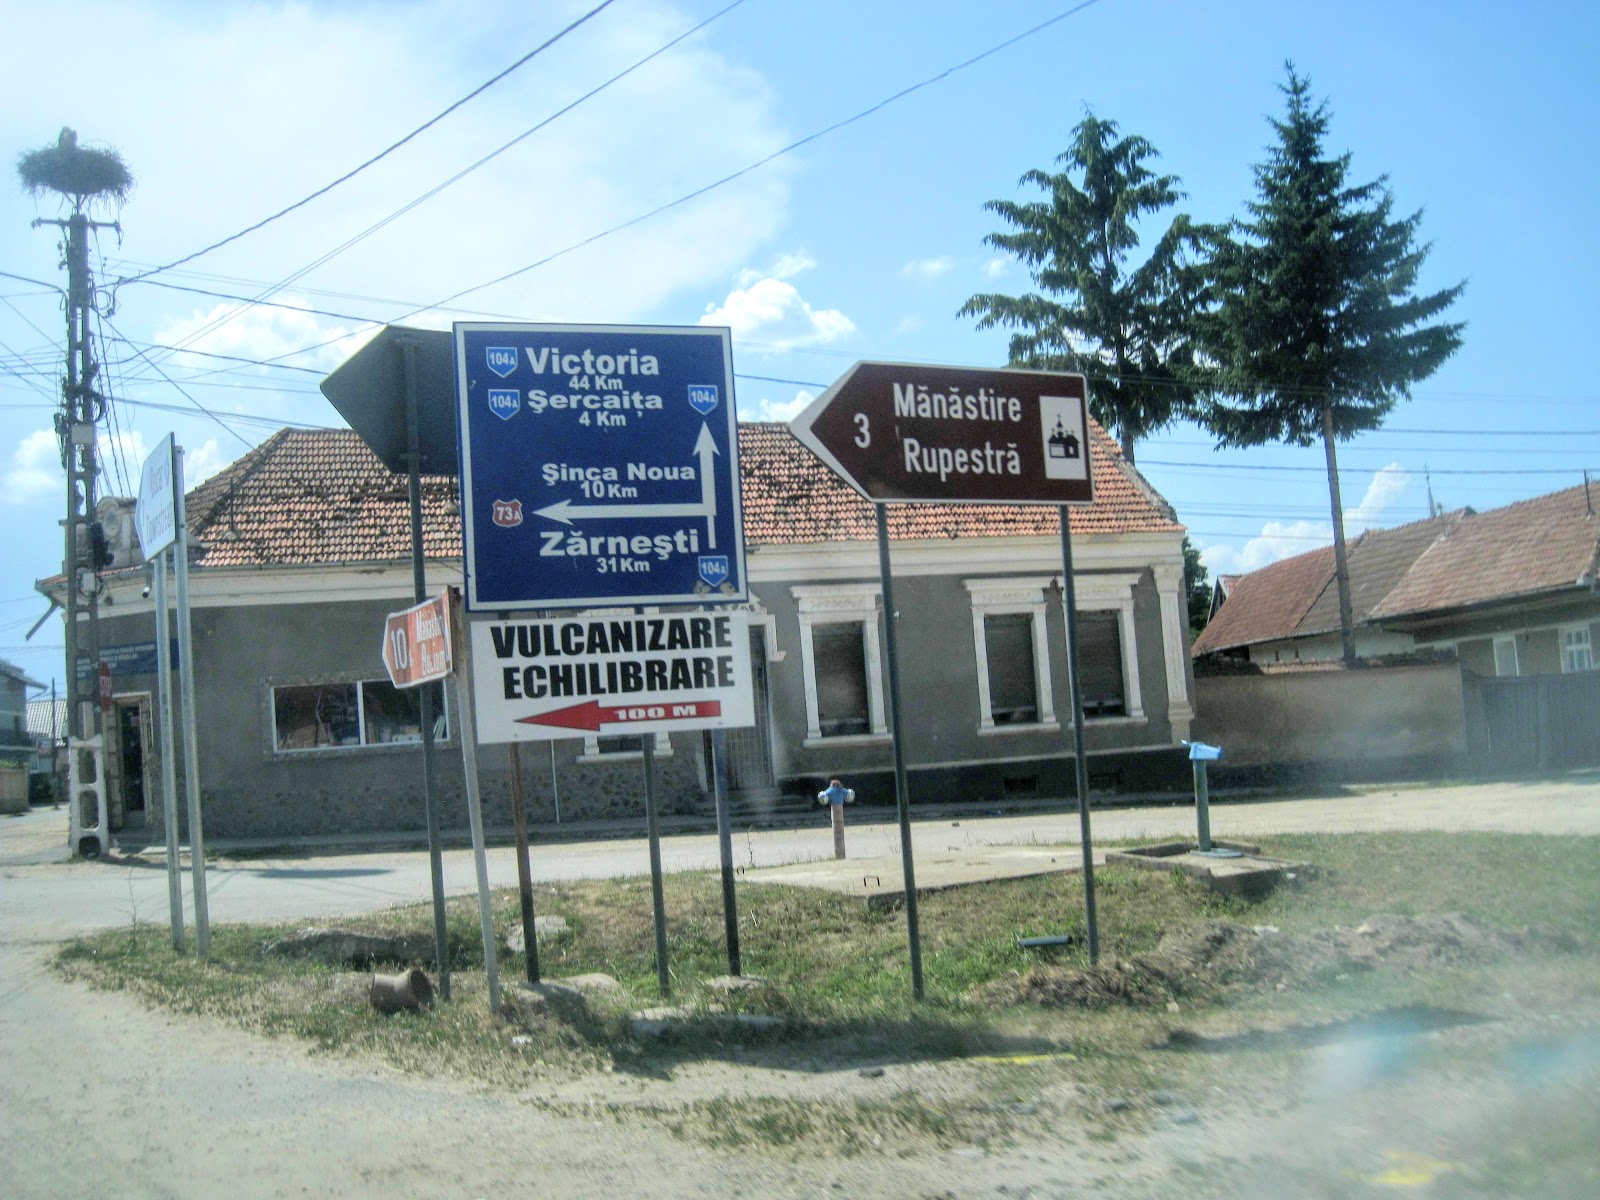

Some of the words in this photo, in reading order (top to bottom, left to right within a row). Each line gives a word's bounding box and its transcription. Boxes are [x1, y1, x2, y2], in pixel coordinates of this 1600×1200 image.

[489, 352, 516, 366] 104A
[525, 347, 659, 375] Victoria
[569, 376, 590, 390] 44
[595, 375, 623, 390] Km
[491, 395, 519, 409] 104A
[893, 382, 1022, 422] Mănăstire
[579, 412, 591, 426] 4
[596, 411, 627, 427] Km
[854, 413, 871, 449] 3
[903, 437, 1022, 482] Rupestră
[627, 463, 695, 481] Noua
[580, 481, 604, 498] 10
[608, 484, 638, 498] Km
[496, 507, 521, 521] 73A
[597, 559, 616, 573] 31
[620, 558, 650, 573] Km
[701, 561, 727, 575] 104A
[490, 616, 732, 658] VULCANIZARE
[390, 628, 408, 670] 10
[503, 656, 735, 700] ECHILIBRARE
[614, 707, 665, 720] 100
[672, 704, 697, 717] M
